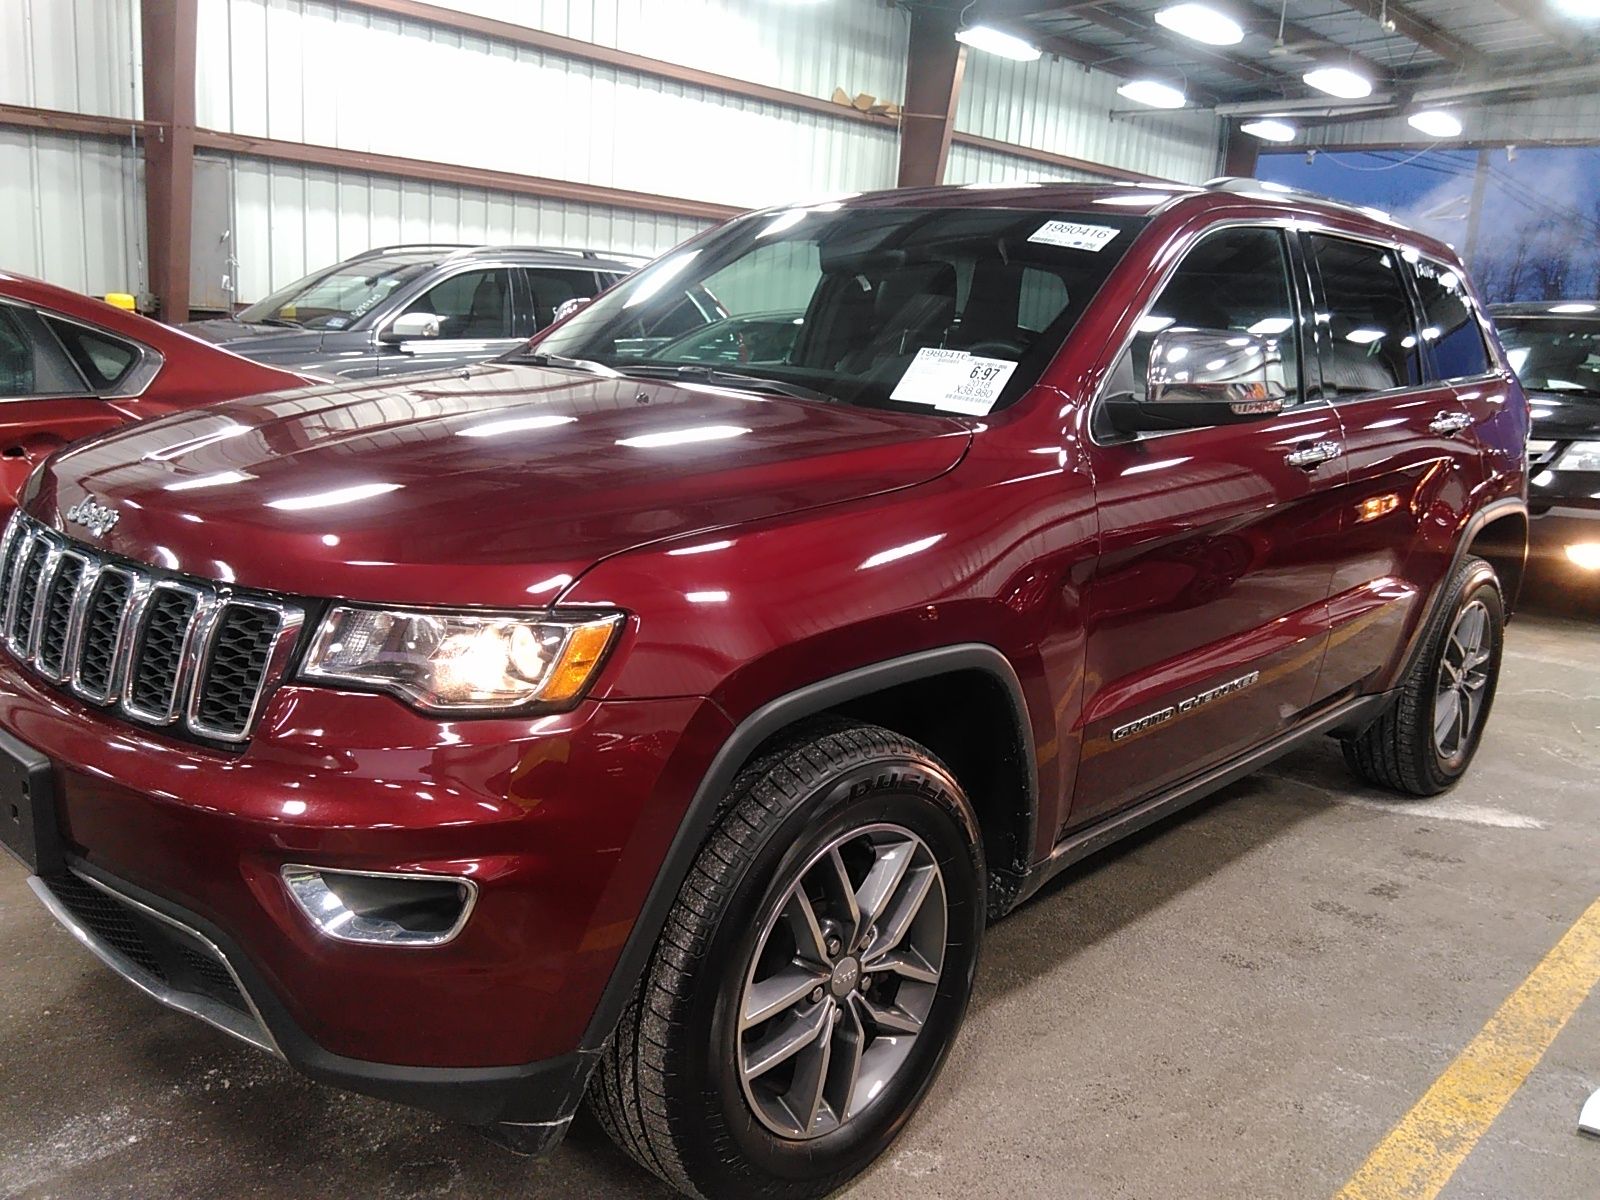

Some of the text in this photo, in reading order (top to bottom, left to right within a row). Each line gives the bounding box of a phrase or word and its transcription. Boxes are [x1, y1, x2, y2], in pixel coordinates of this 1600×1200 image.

[1045, 223, 1109, 239] 1980416
[969, 366, 1000, 381] 6:97
[966, 380, 991, 389] 2018
[1112, 671, 1260, 741] GRAND CHEROKEE
